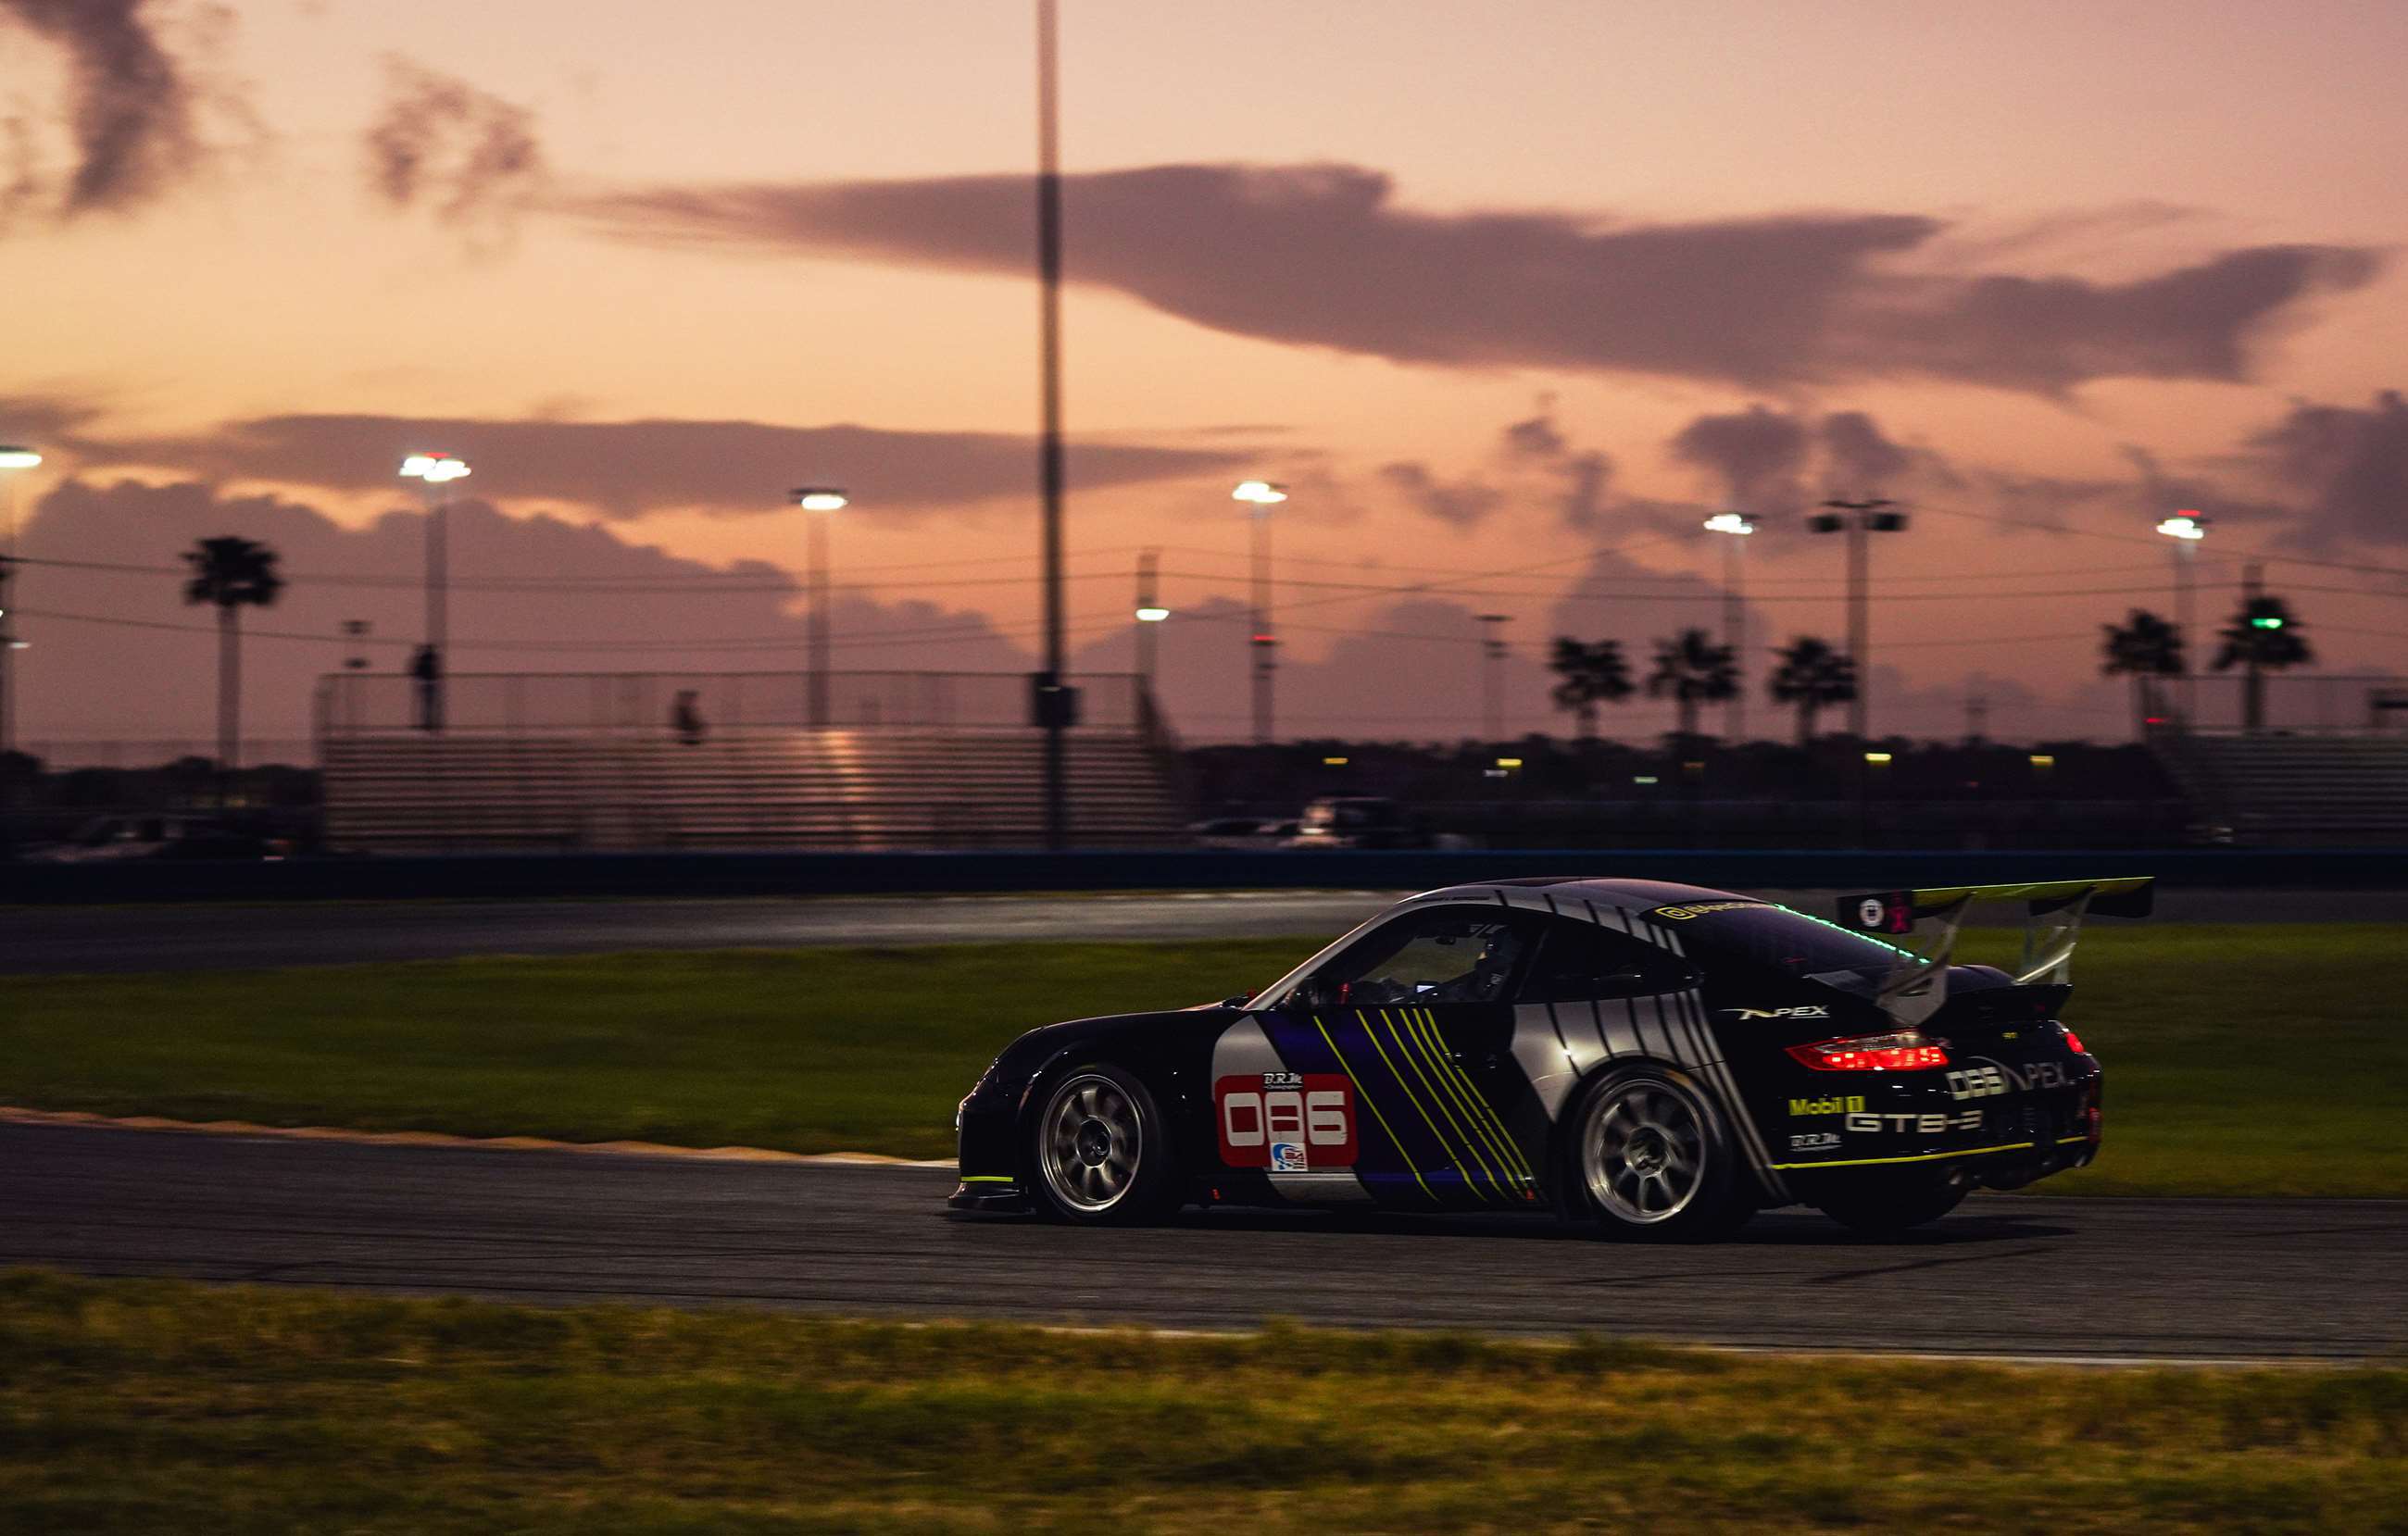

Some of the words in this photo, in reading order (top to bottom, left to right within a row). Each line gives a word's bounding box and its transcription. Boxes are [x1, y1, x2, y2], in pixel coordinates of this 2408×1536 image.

[1719, 1005, 1831, 1020] APEX
[1946, 1066, 2005, 1101] 086
[1223, 1091, 1348, 1147] 086
[1788, 1097, 1845, 1117] Mobil
